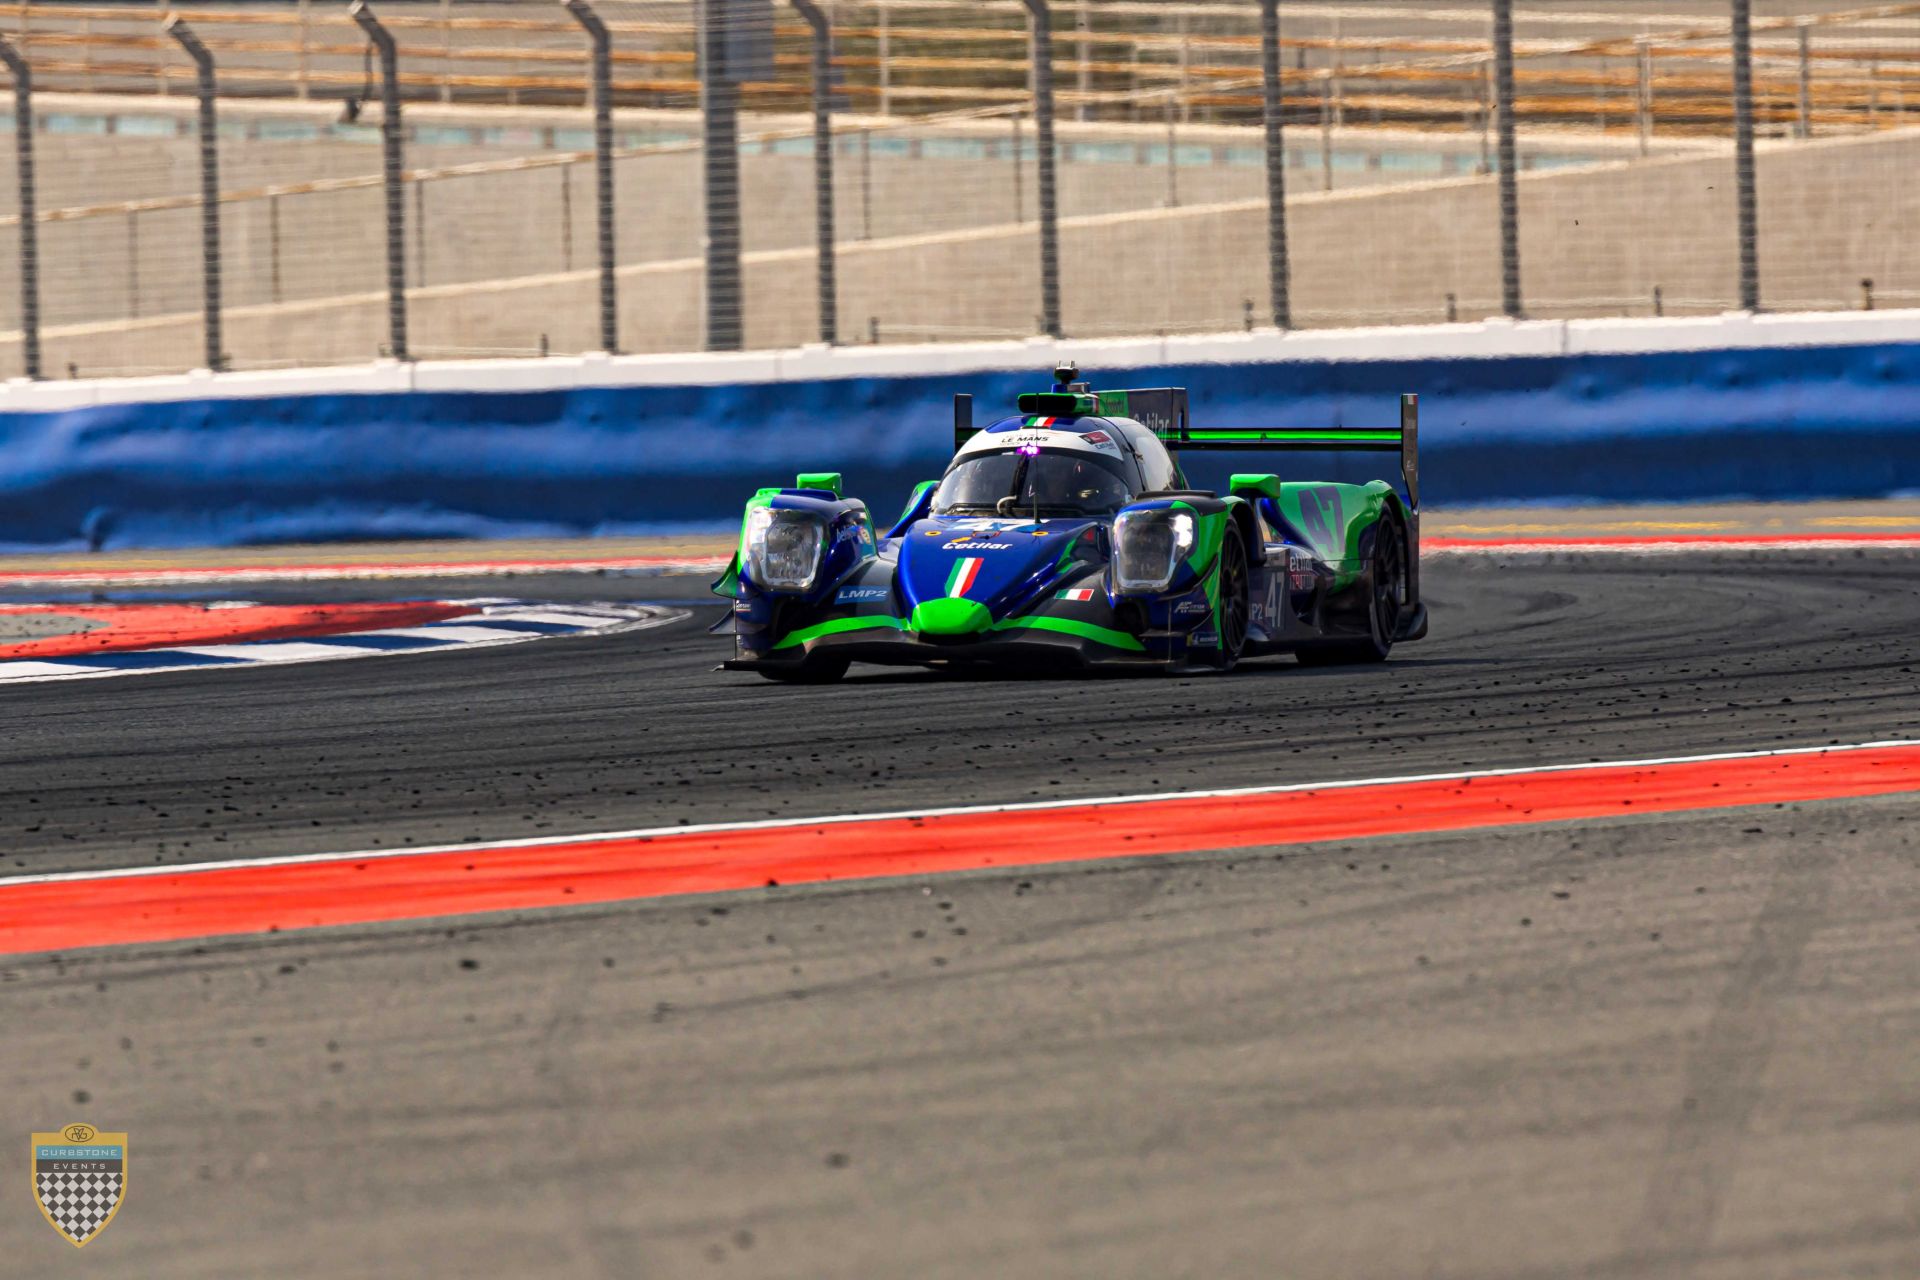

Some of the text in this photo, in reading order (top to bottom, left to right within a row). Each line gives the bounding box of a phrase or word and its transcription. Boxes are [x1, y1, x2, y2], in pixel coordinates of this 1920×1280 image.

[951, 518, 1051, 532] 47
[1297, 486, 1345, 553] 47
[839, 590, 888, 599] LMP2
[1265, 572, 1285, 628] 47
